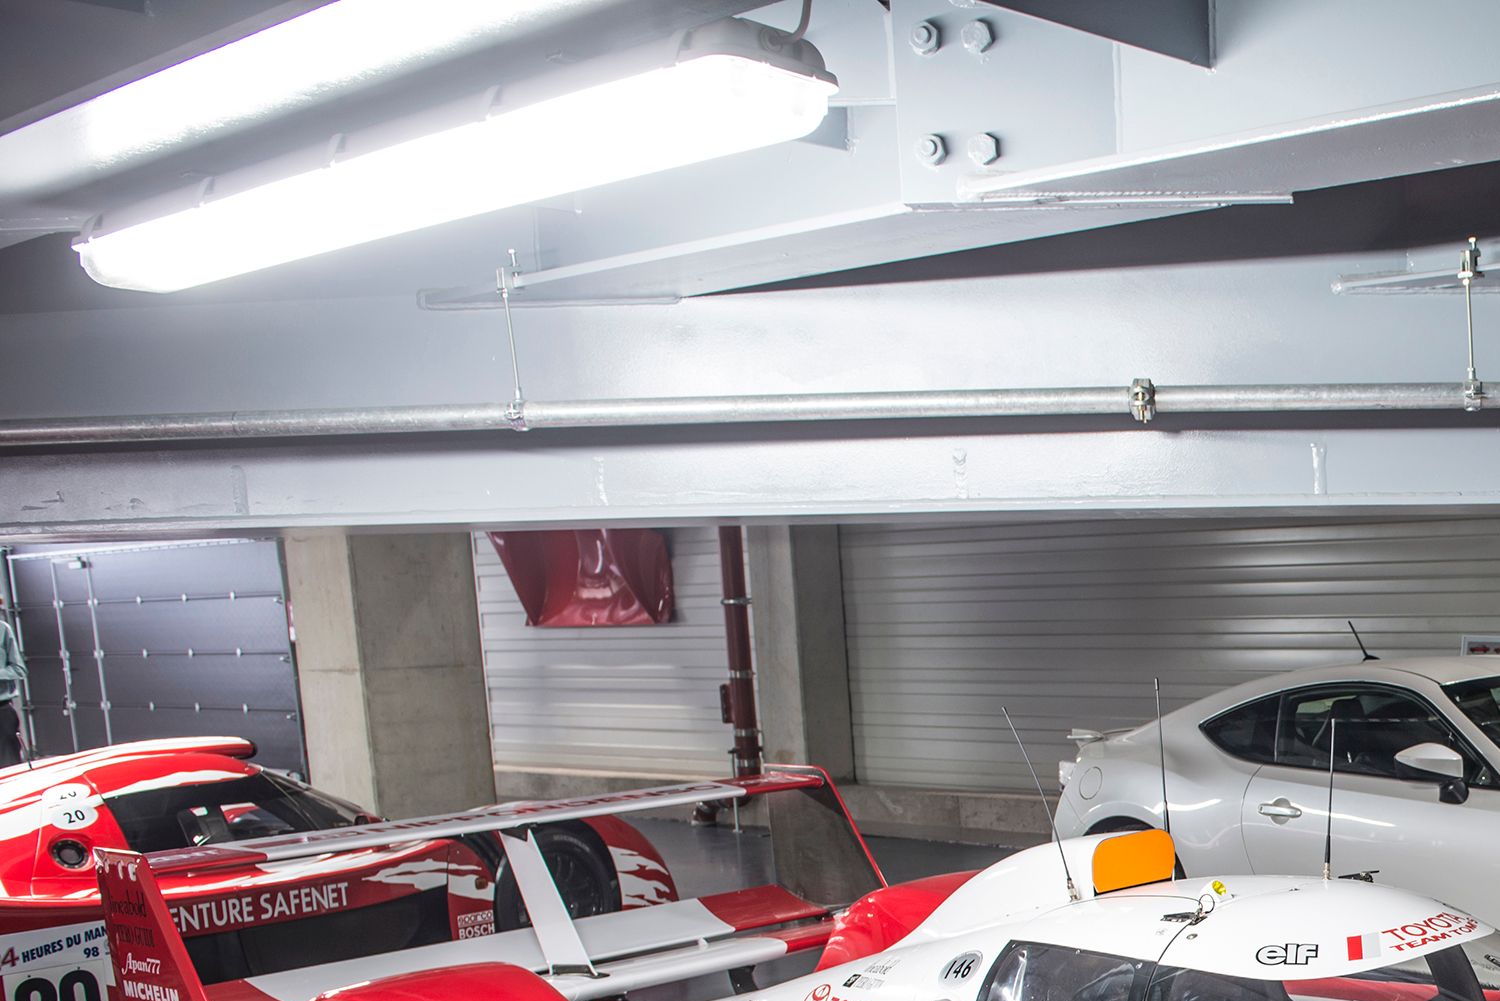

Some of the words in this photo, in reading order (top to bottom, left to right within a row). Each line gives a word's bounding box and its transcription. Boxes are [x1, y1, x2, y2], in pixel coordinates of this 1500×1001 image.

[63, 809, 85, 824] 20
[259, 882, 349, 920] SAFENET
[458, 922, 496, 940] BOSCH
[1381, 912, 1465, 941] TOYOTA
[0, 946, 19, 970] 4
[22, 939, 64, 964] HEURES
[66, 934, 81, 949] DU
[1389, 932, 1452, 952] TEAM
[83, 946, 100, 959] 98
[1255, 943, 1319, 966] elf
[944, 959, 976, 979] 146
